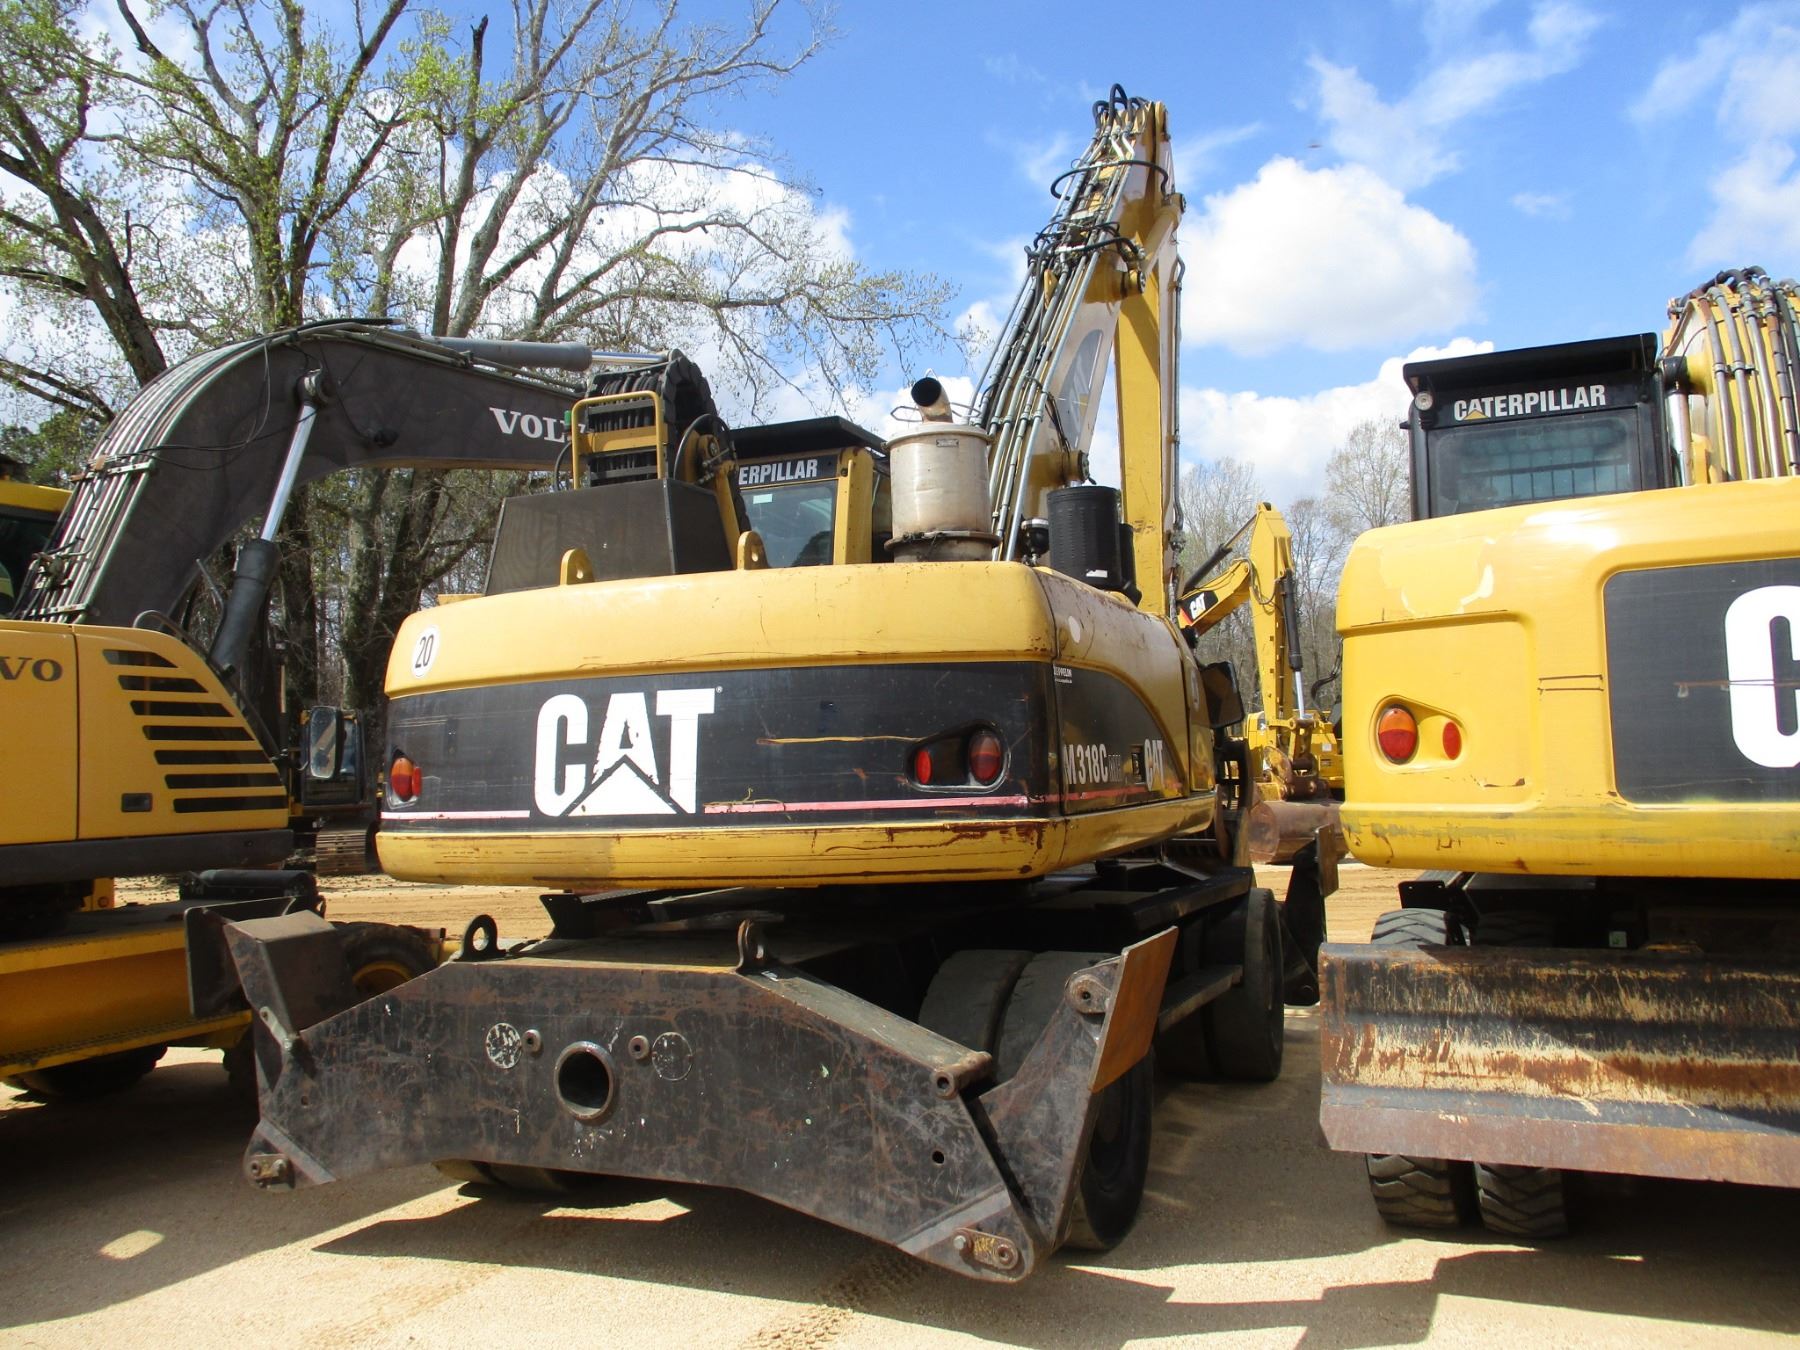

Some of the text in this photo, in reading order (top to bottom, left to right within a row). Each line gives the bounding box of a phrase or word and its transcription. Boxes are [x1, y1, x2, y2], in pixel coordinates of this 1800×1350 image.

[1454, 384, 1606, 421] CATERPILLAR
[1190, 592, 1206, 620] CAT
[415, 634, 434, 668] 20
[535, 688, 715, 817] CAT
[1144, 739, 1166, 792] CAT
